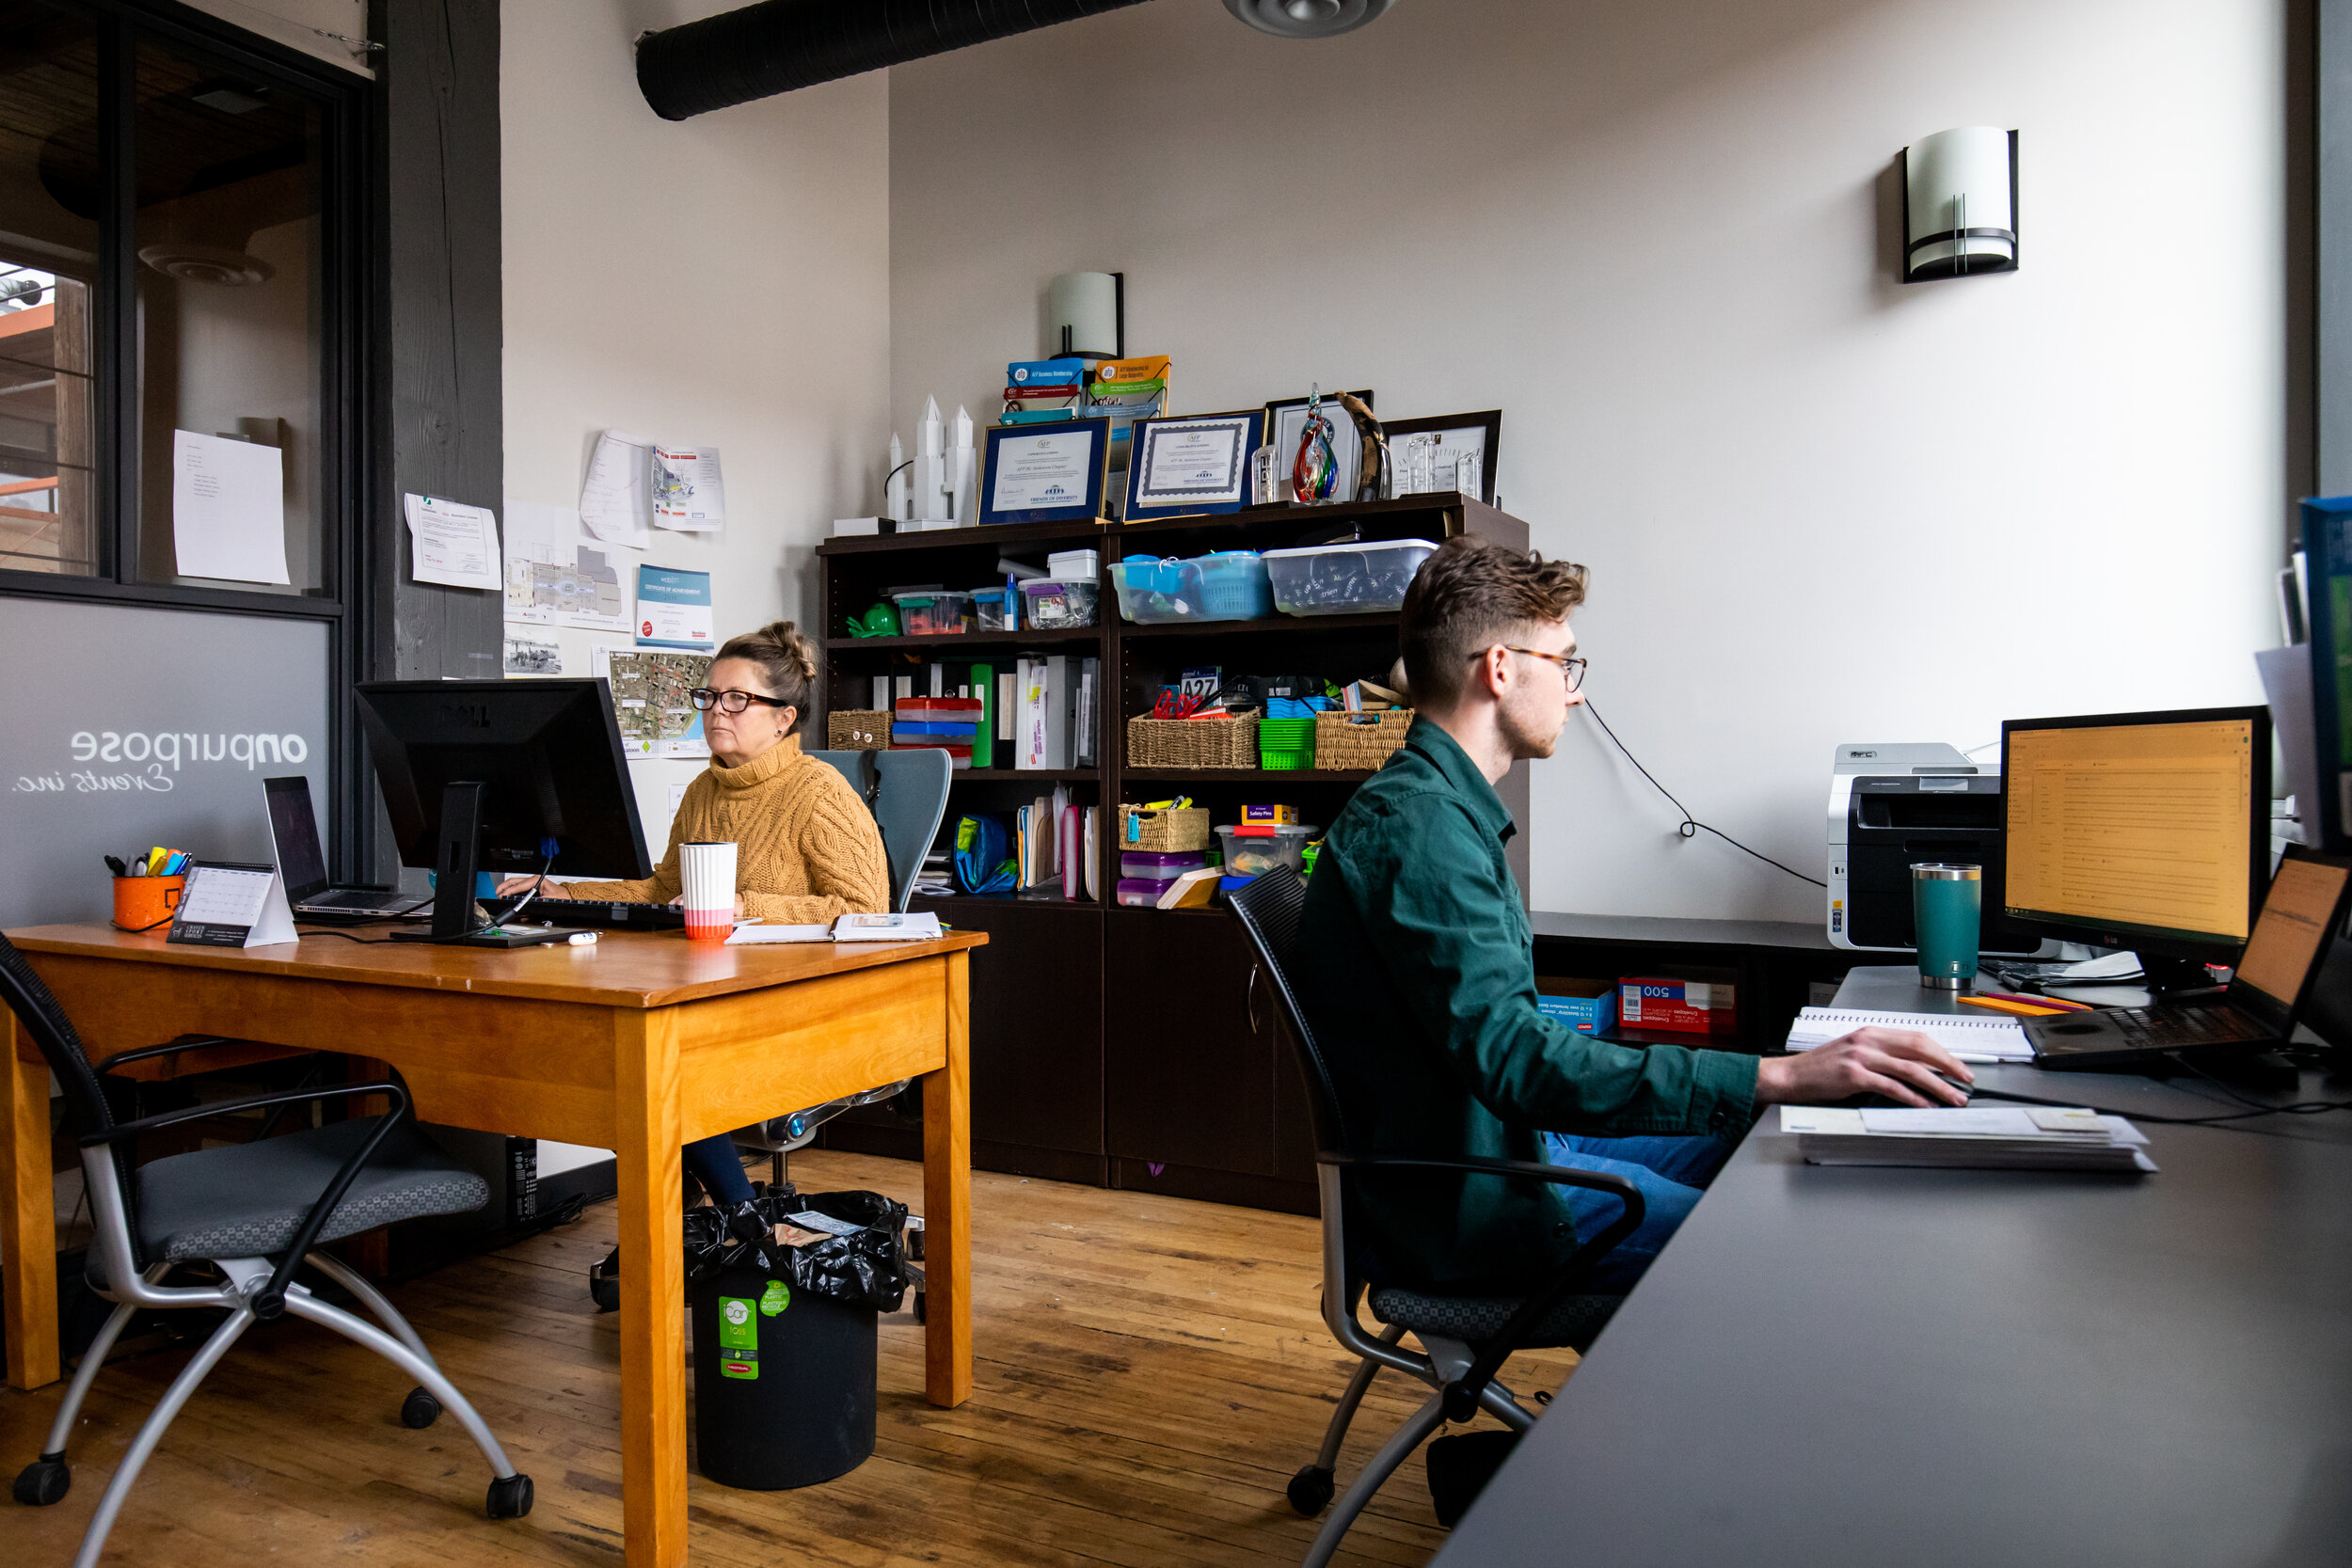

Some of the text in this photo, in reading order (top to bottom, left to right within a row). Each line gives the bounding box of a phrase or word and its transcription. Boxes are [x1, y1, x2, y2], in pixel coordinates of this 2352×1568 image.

[1184, 679, 1216, 699] A27
[1644, 986, 1669, 998] 500
[723, 1304, 749, 1319] iCan
